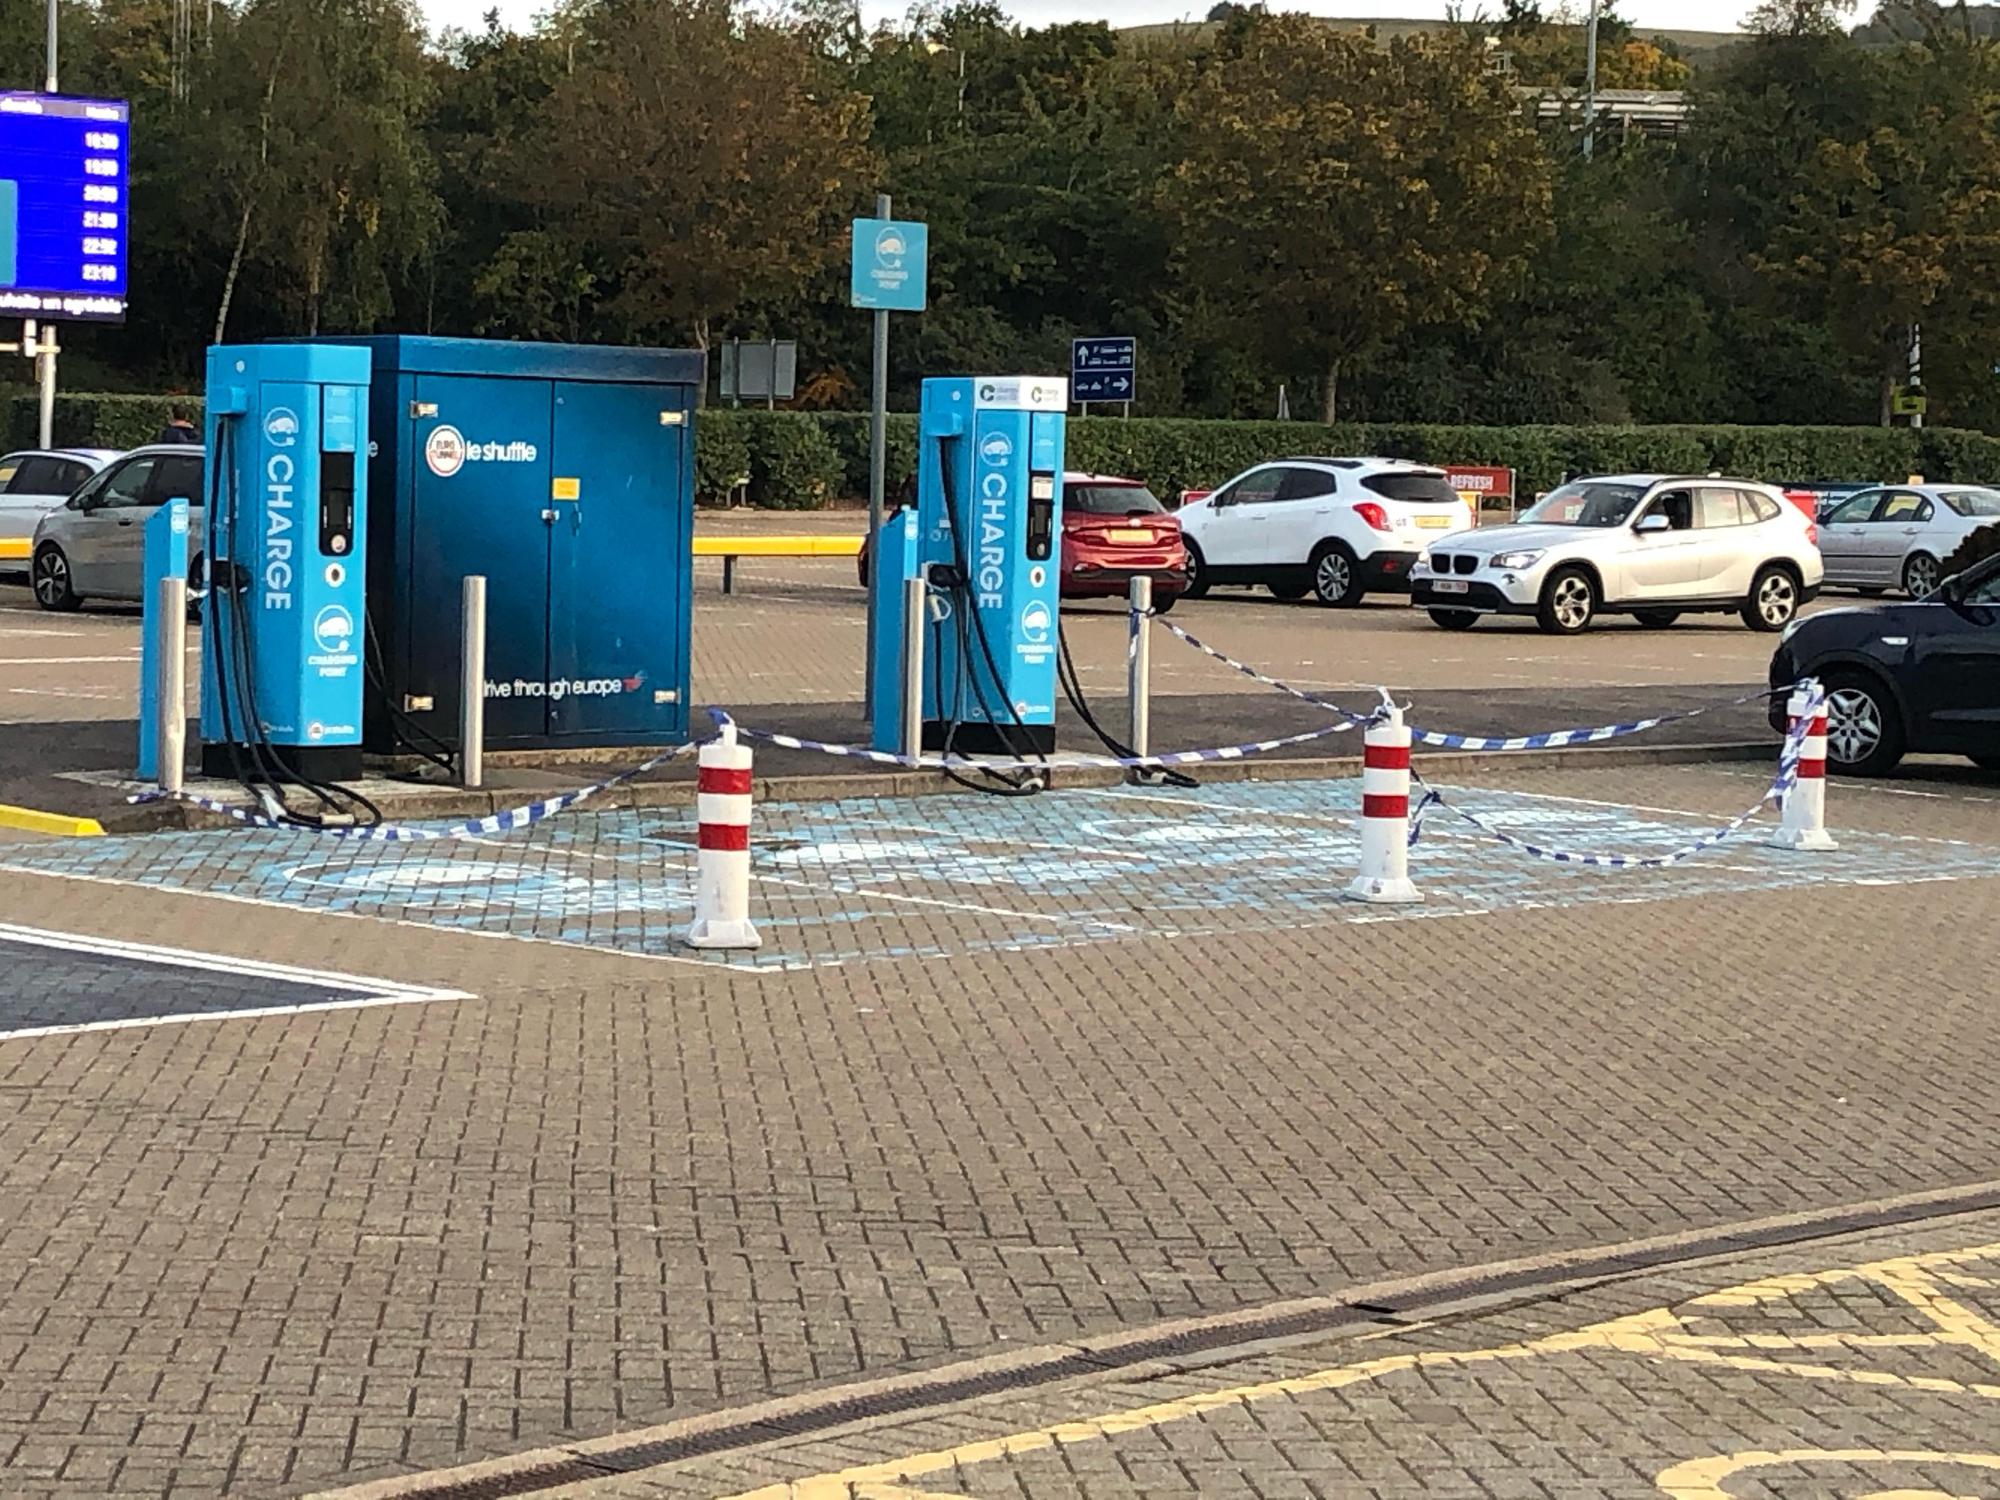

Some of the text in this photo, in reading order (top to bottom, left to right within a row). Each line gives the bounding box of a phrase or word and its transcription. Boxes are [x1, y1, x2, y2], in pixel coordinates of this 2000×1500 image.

[466, 440, 537, 463] le shuffle
[265, 453, 296, 611] CHARGE
[978, 473, 1008, 609] CHARGE
[483, 676, 622, 700] rive through europe
